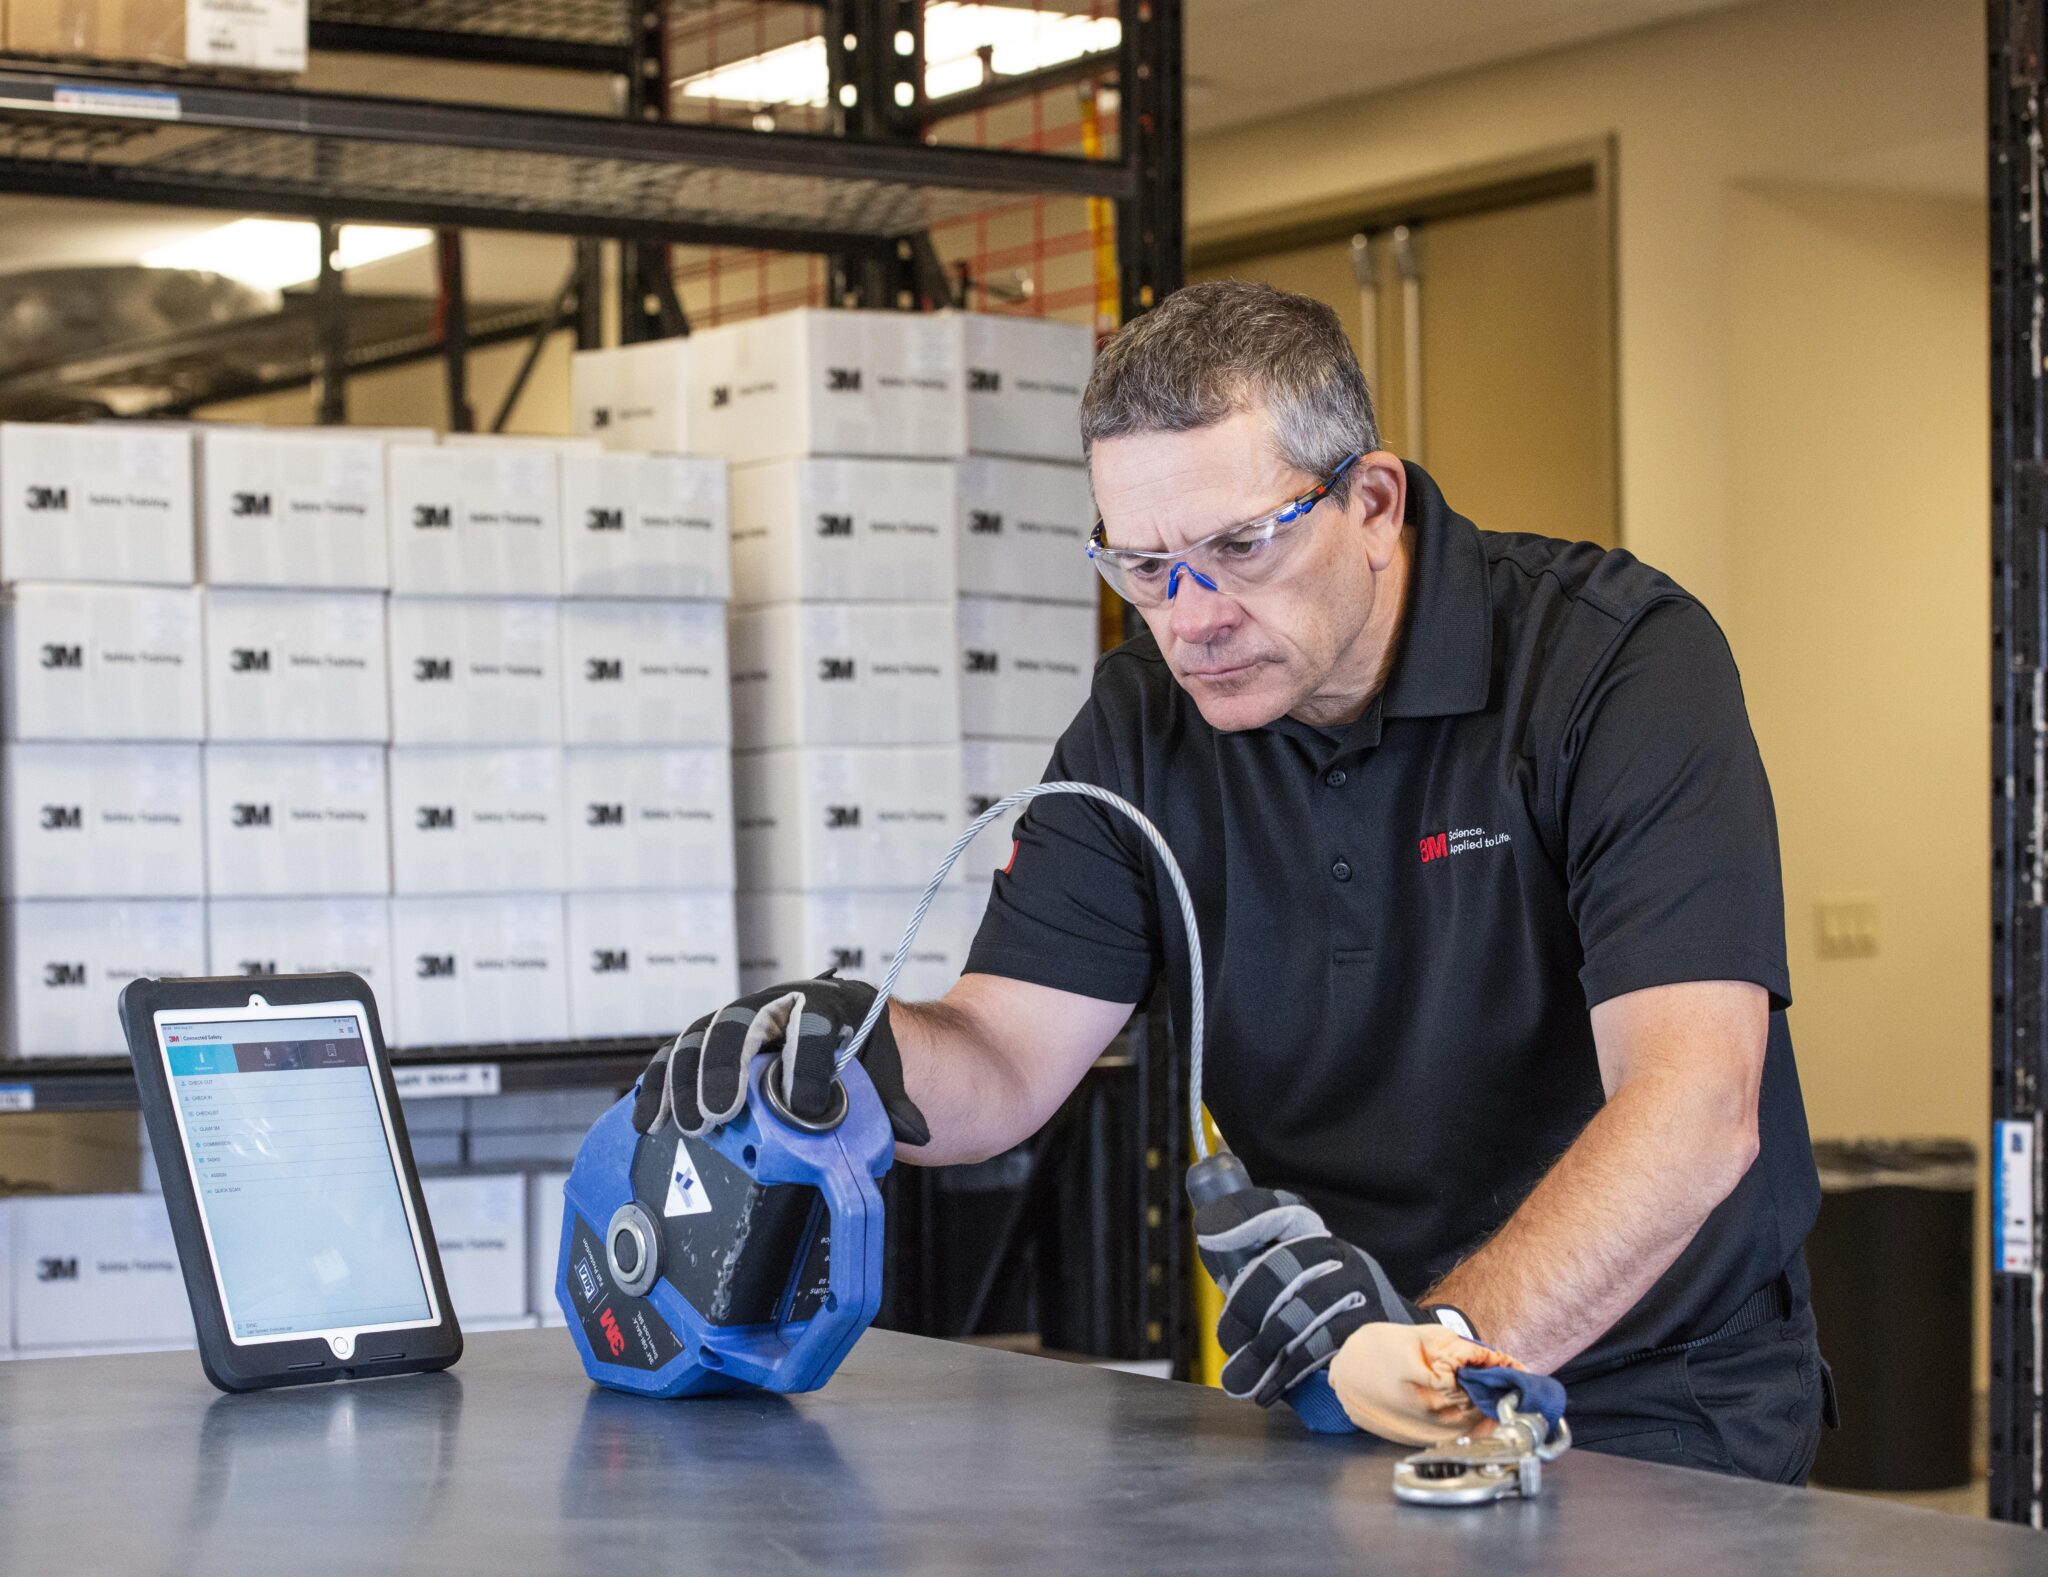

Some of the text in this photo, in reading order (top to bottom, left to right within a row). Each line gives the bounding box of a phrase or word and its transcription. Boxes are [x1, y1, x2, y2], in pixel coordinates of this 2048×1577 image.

[828, 368, 862, 392] 3M
[967, 369, 1001, 393] 3M
[27, 486, 68, 511] 3M
[233, 493, 272, 517] 3M
[414, 505, 451, 529] 3M
[588, 508, 624, 531] 3M
[818, 514, 853, 537] 3M
[969, 510, 1003, 535] 3M
[42, 644, 83, 669] 3M
[231, 649, 270, 672] 3M
[965, 650, 999, 674] 3M
[415, 658, 452, 681] 3M
[587, 659, 623, 682] 3M
[820, 658, 855, 681] 3M
[41, 806, 82, 830] 3M
[233, 803, 272, 828] 3M
[418, 807, 455, 830] 3M
[588, 804, 624, 827] 3M
[826, 806, 861, 829] 3M
[1448, 827, 1486, 841] Science.
[1450, 832, 1511, 855] Applied to Life.
[1419, 832, 1448, 863] 3M
[417, 955, 456, 979] 3M
[593, 950, 629, 973] 3M
[832, 949, 863, 970] 3M
[45, 962, 86, 988] 3M
[168, 1035, 180, 1043] 3M
[582, 1237, 599, 1275] Protection
[37, 1256, 80, 1283] 3M
[595, 1273, 604, 1287] Fall
[600, 1307, 624, 1356] 3M
